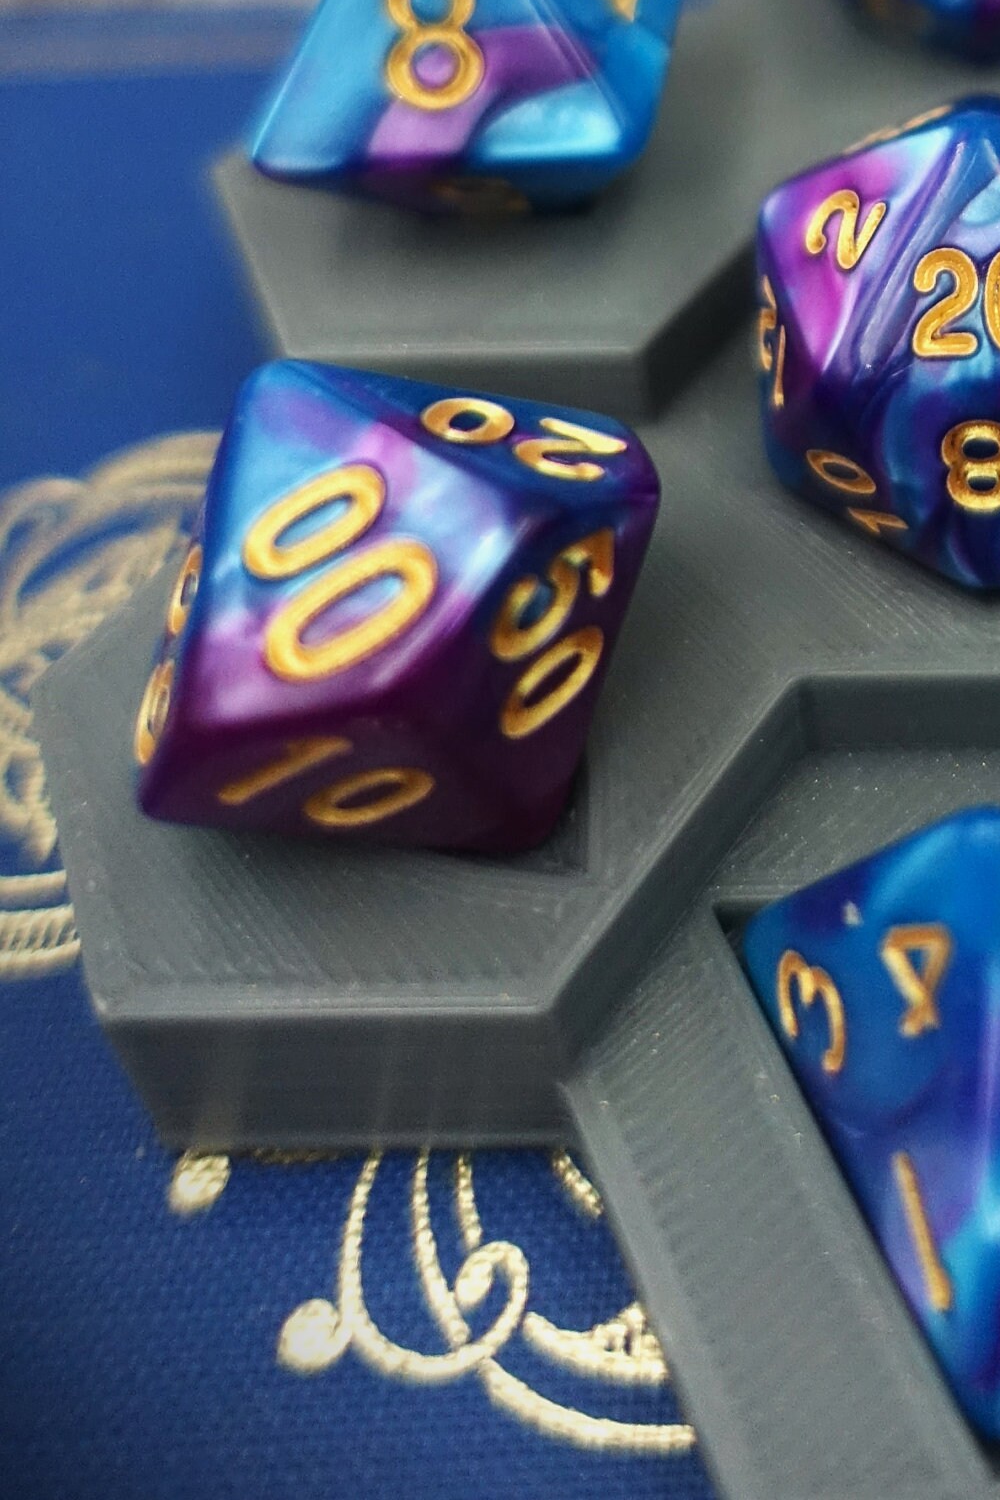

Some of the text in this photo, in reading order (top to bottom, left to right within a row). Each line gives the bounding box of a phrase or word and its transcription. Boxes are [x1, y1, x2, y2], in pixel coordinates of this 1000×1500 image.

[806, 189, 886, 269] 2
[421, 396, 627, 482] 20
[243, 462, 439, 683] 00
[218, 737, 434, 828] 10
[777, 949, 845, 1072] 3
[892, 1151, 952, 1310] 1
